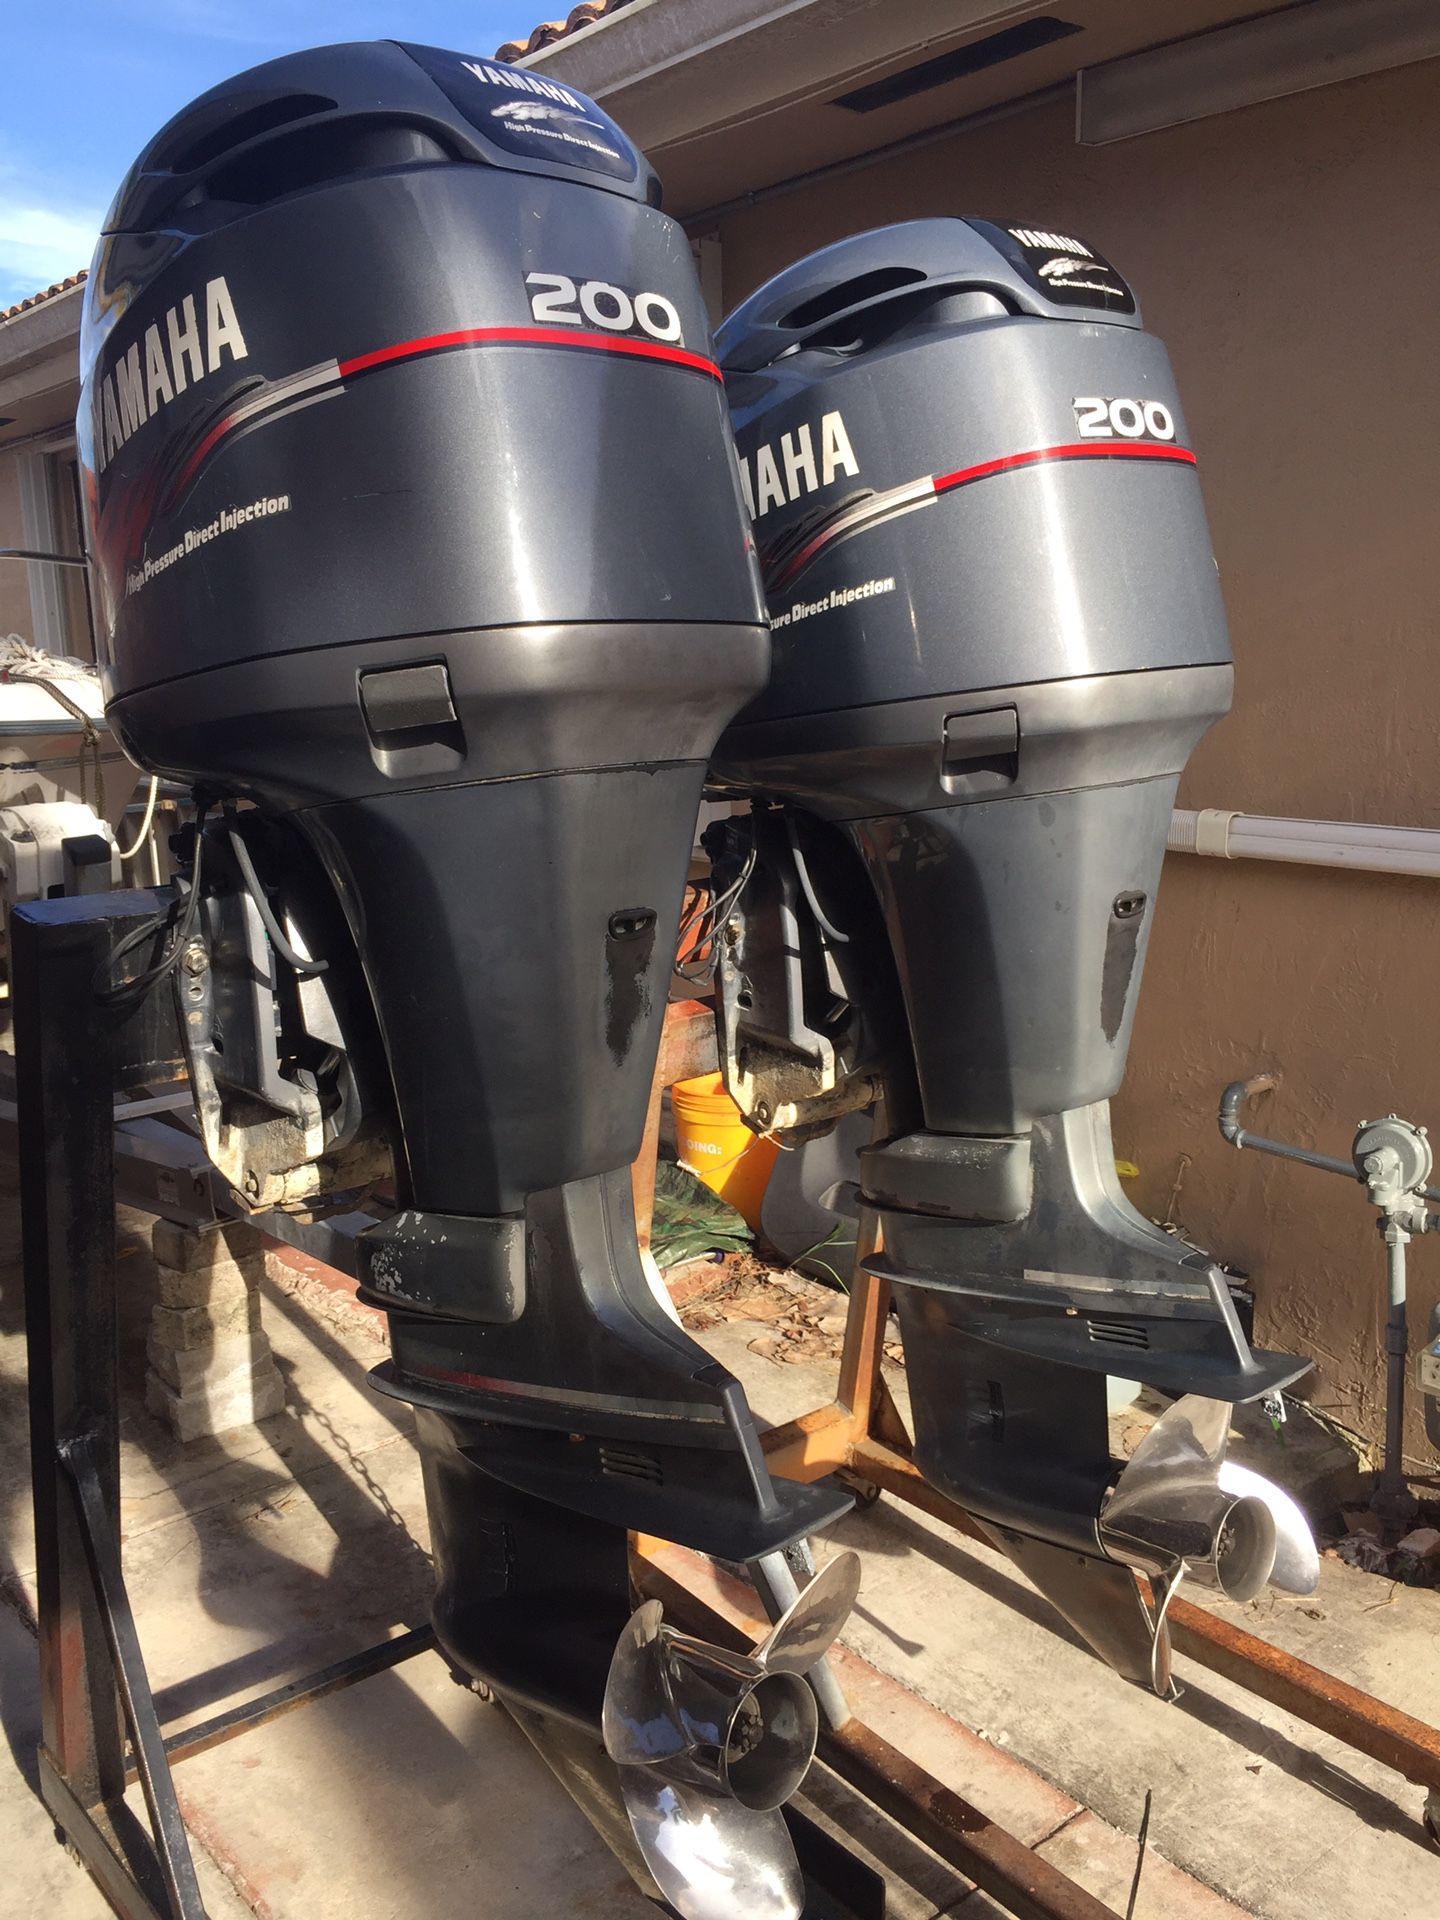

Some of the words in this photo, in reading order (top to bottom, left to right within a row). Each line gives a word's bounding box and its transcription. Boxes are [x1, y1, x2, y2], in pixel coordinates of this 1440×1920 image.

[460, 61, 586, 112] YAMAHA
[504, 120, 525, 132] High
[525, 124, 563, 140] Pressure
[1008, 229, 1094, 258] YAMAHA
[525, 272, 681, 341] 200
[1074, 398, 1174, 440] 200
[144, 543, 184, 582] Pressure
[184, 520, 220, 553] Direct
[220, 495, 289, 533] Injection
[769, 613, 791, 632] sure
[792, 597, 830, 623] Direct
[830, 577, 895, 609] Injection
